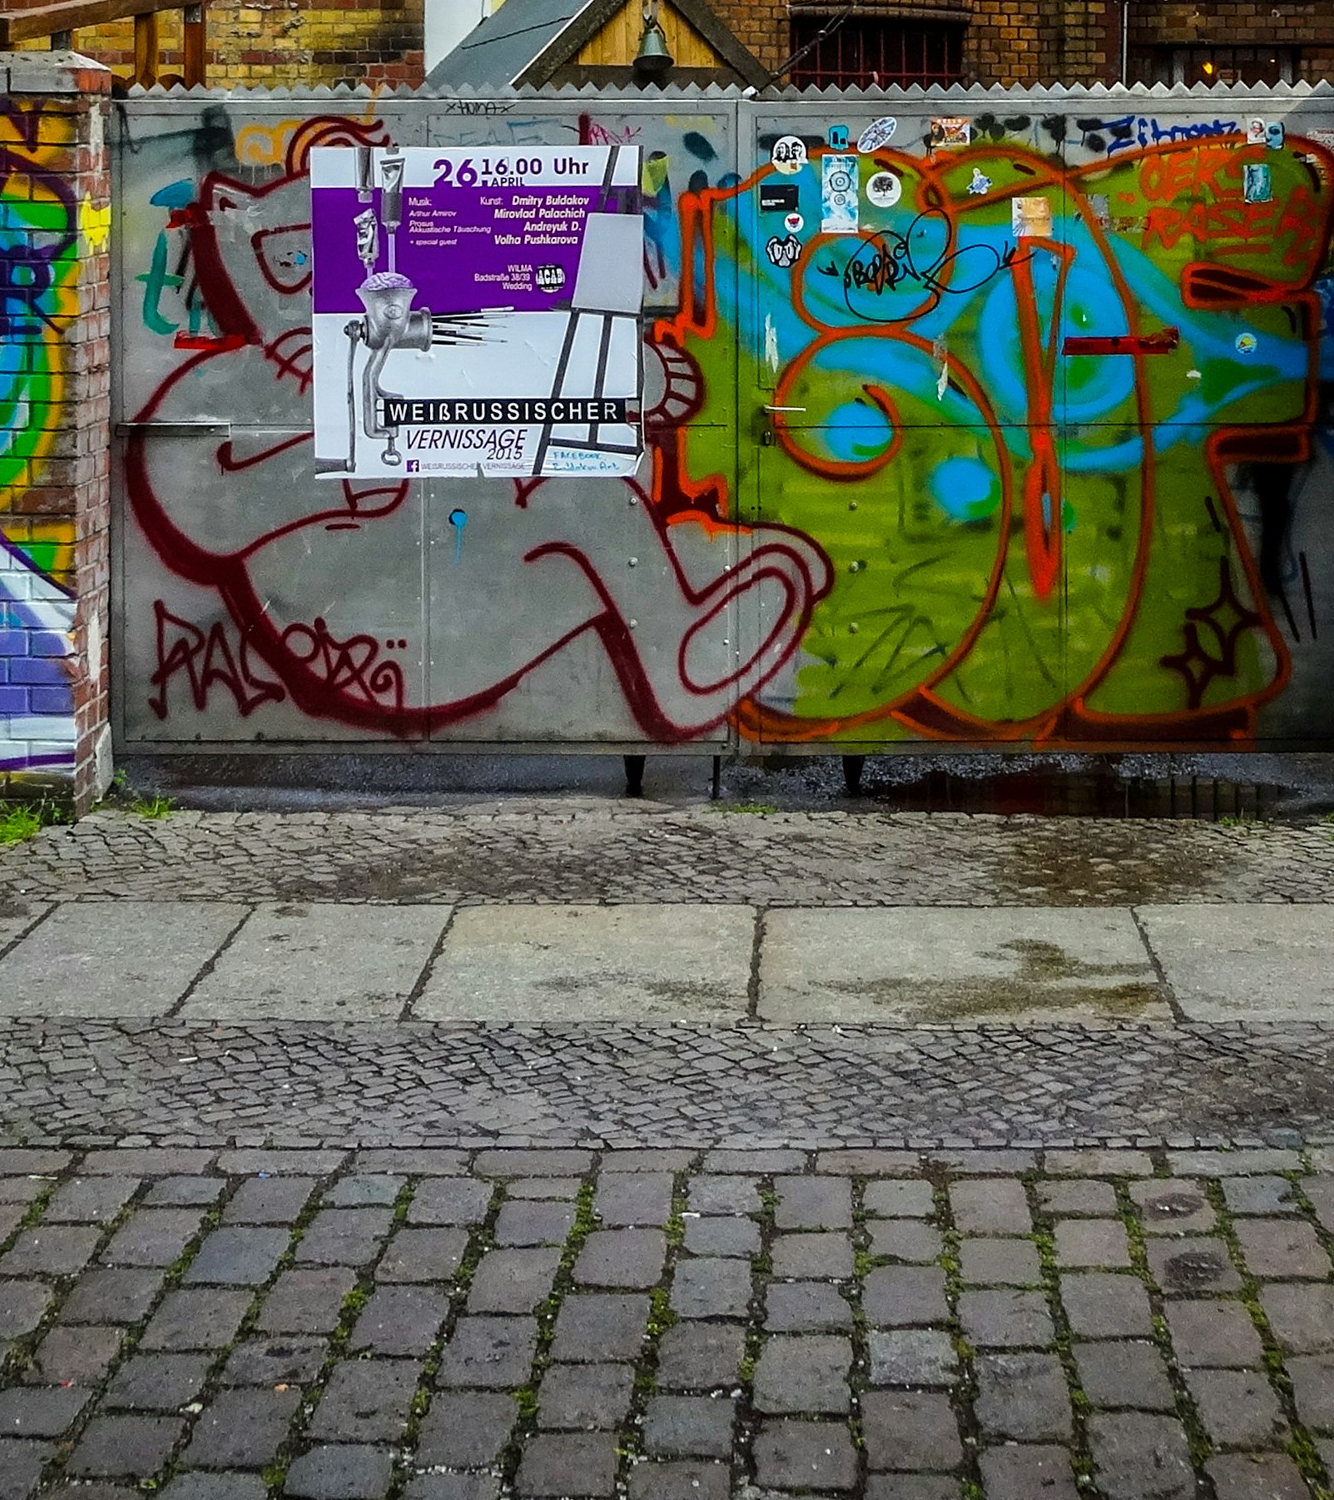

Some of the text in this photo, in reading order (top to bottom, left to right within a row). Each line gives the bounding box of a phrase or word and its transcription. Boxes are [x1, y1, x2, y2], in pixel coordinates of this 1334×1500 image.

[481, 157, 589, 176] 16.00 Uhr
[491, 177, 525, 187] APRIL
[512, 196, 543, 207] Dmitry
[546, 196, 589, 205] Buldakov
[494, 208, 585, 219] Mirovlad Palachich
[524, 221, 582, 234] Andreyuk D.
[494, 235, 578, 245] Volha Pushkarova
[507, 265, 533, 273] WILMA
[406, 429, 528, 450] VERNISSAGE
[487, 448, 523, 461] 2015
